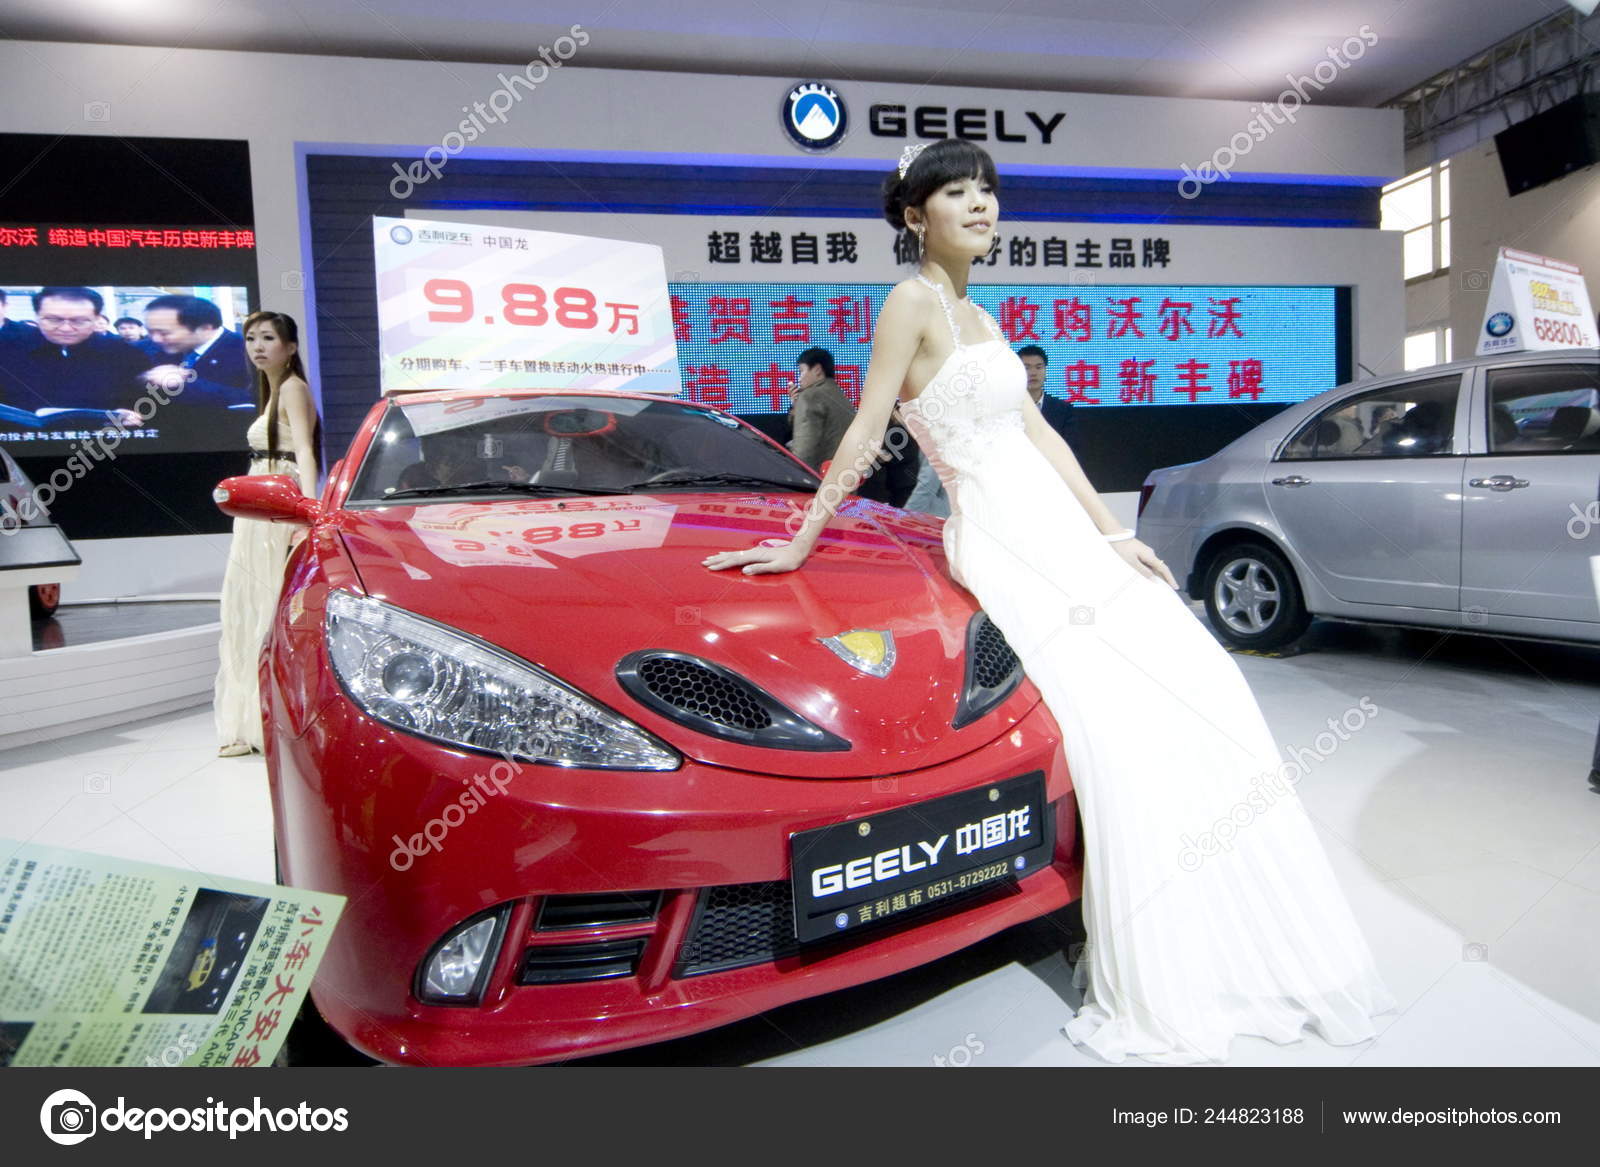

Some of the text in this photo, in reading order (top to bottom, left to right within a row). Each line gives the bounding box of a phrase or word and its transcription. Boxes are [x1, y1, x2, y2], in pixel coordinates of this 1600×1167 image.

[869, 104, 1066, 144] GEELY
[48, 228, 255, 249] 缔造中国汽车历史新丰碑
[483, 235, 529, 251] 中国龙
[707, 230, 858, 264] 超越自我
[811, 805, 1031, 898] GEELY 中国龙
[858, 862, 1008, 924] 吉利超市 0531-87292222
